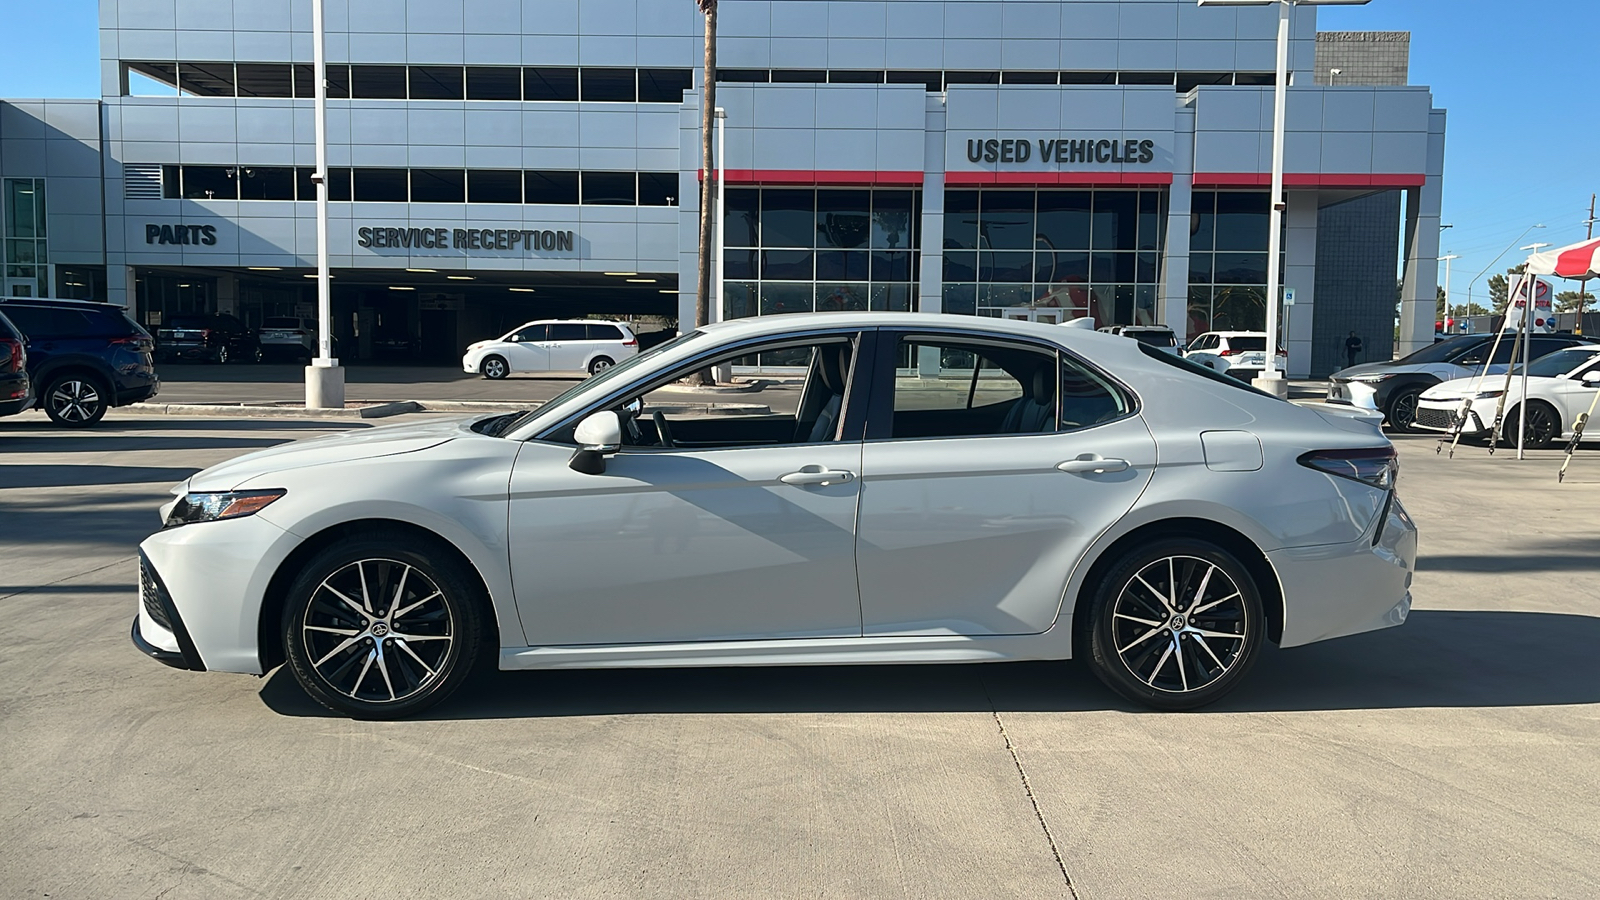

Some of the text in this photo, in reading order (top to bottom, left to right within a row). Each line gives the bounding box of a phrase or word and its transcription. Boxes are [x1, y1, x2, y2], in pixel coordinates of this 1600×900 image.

[967, 139, 1154, 164] USED VEHICLES
[145, 224, 217, 246] PARTS
[357, 227, 573, 251] SERVICE RECEPTION
